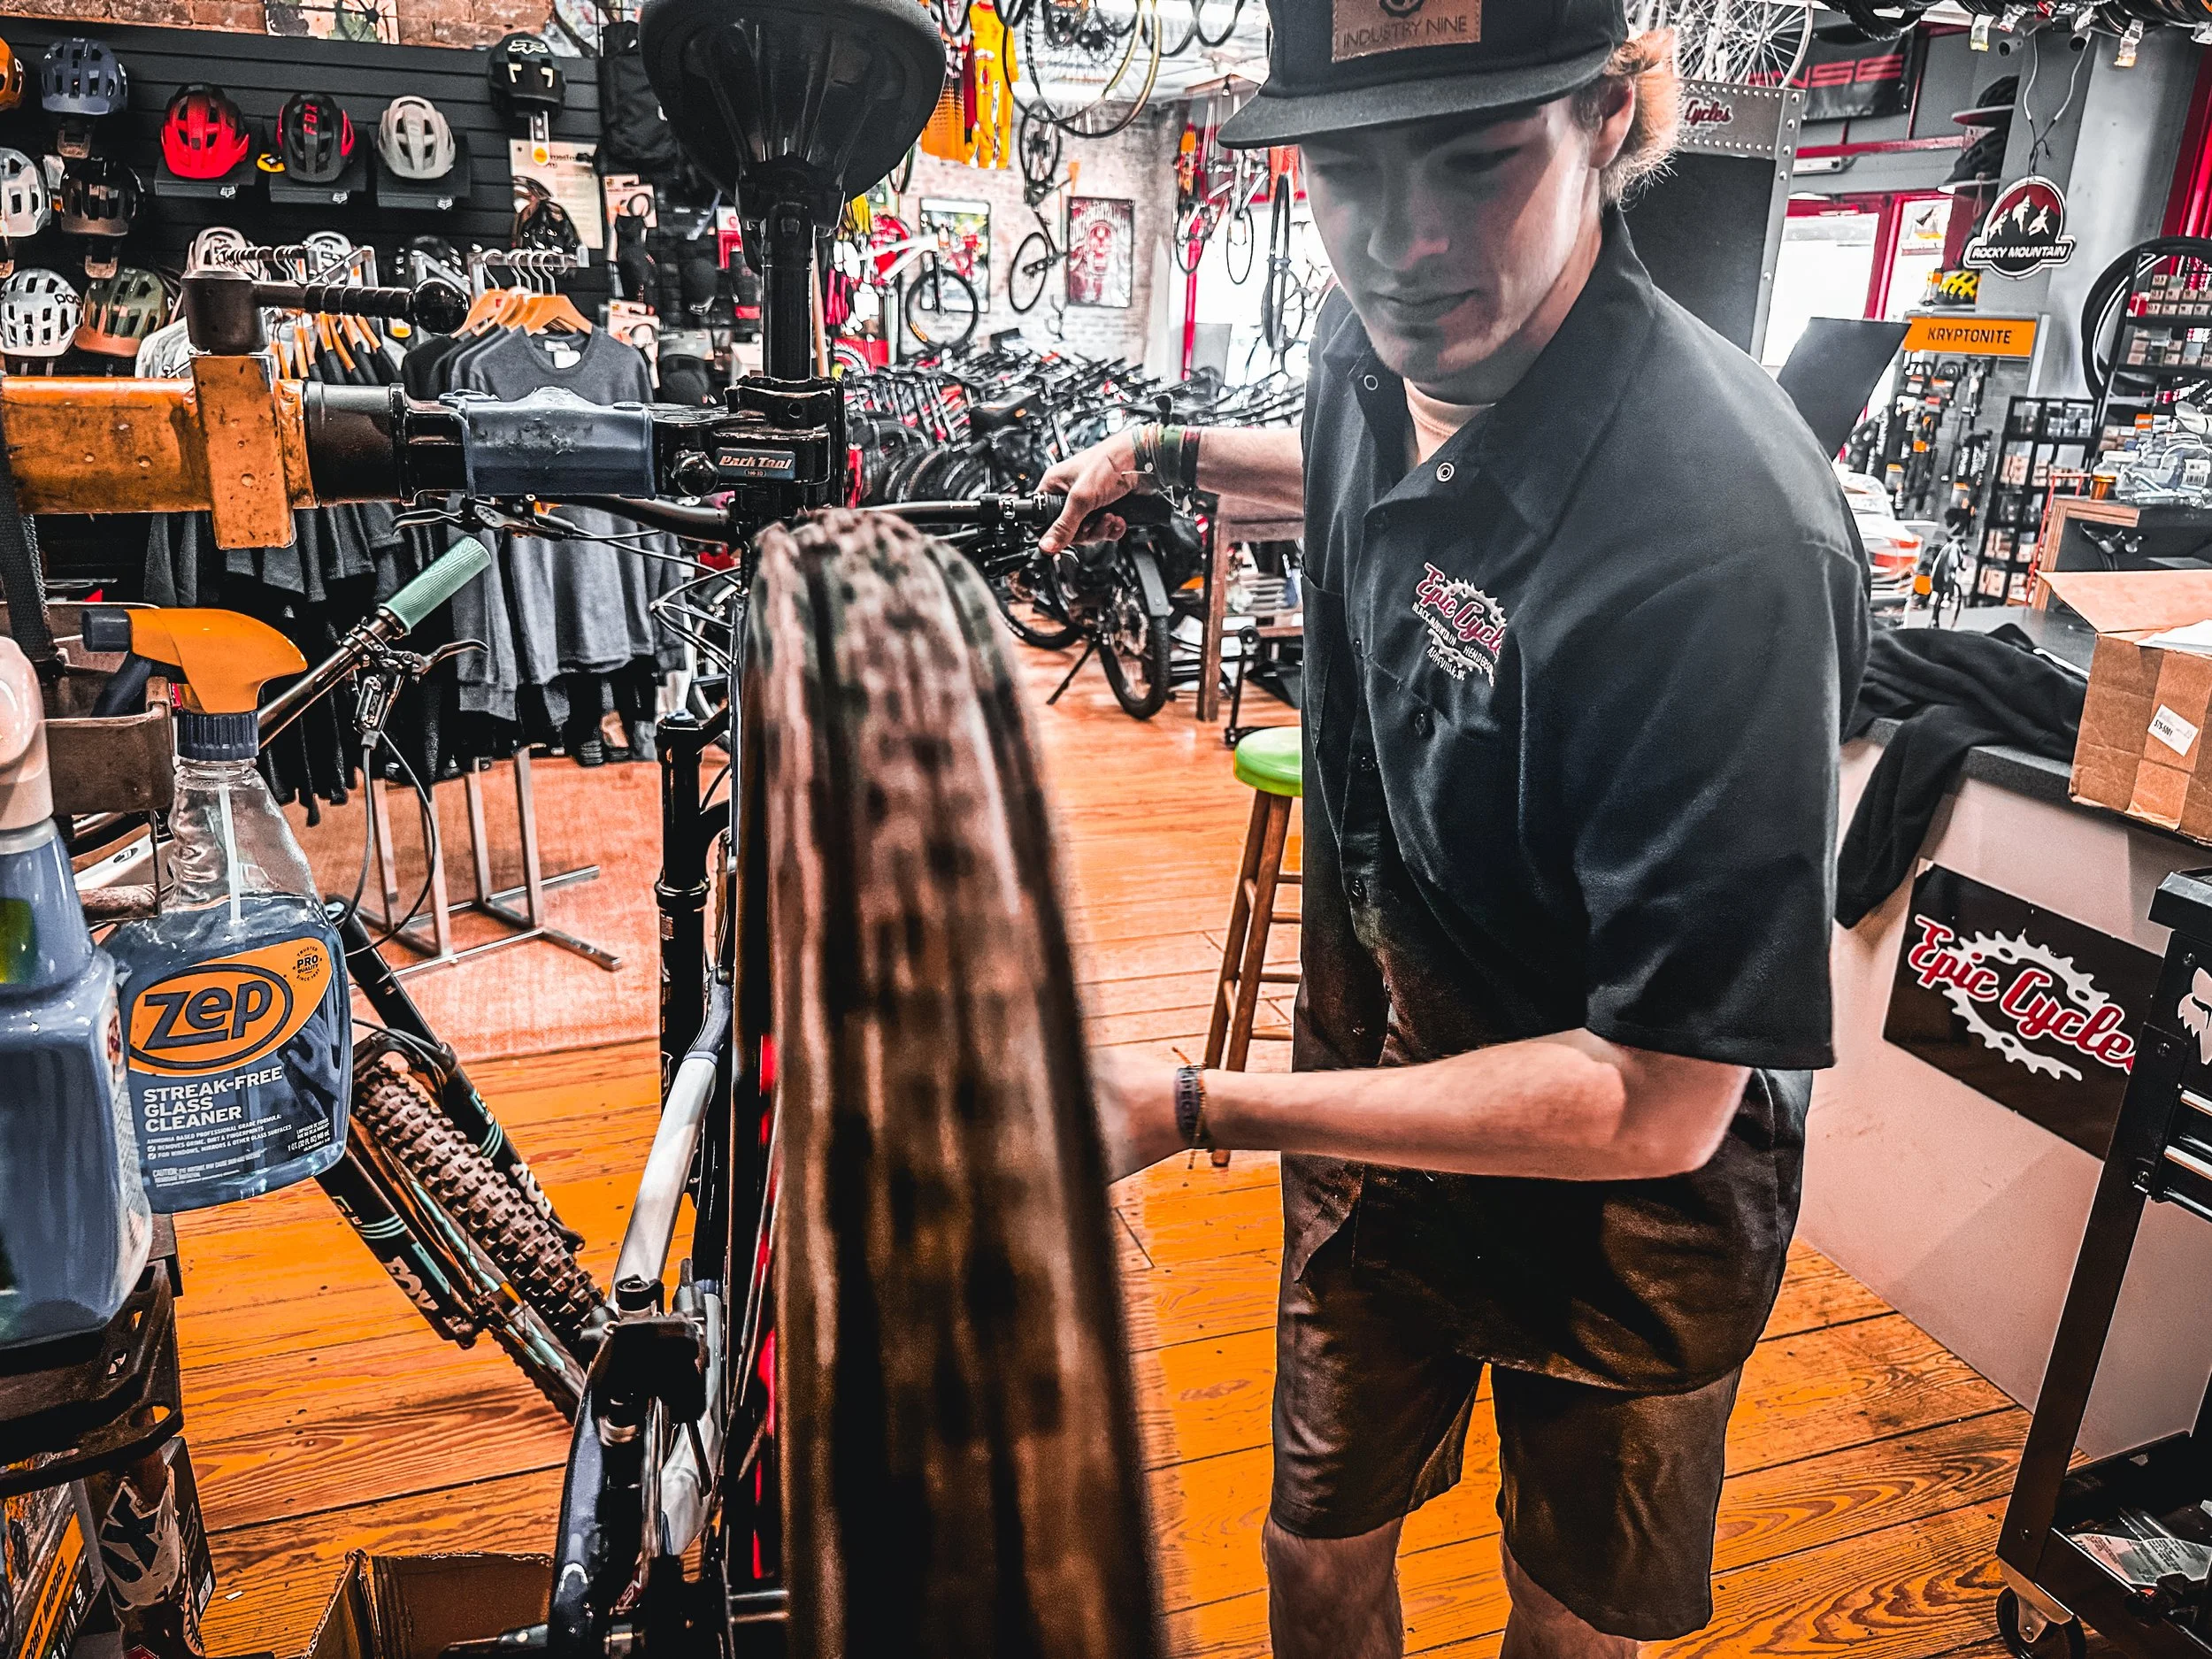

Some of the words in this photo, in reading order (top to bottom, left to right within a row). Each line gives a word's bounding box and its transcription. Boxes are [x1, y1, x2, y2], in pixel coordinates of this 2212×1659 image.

[1343, 18, 1423, 49] INDUSTRY
[1425, 15, 1467, 35] NINE
[303, 104, 319, 135] FOX
[1683, 97, 1733, 127] Cycles
[1971, 246, 2008, 258] ROCKY
[2008, 245, 2068, 258] MOUNTAIN
[1927, 326, 2012, 345] KRYPTONITE
[718, 455, 757, 468] Park
[757, 457, 793, 470] Tool
[1416, 561, 1458, 619] Epic
[1452, 601, 1507, 657] Cycl
[297, 954, 319, 969] PRO
[297, 963, 319, 974] QUALITY
[1908, 914, 2000, 1002] Epic
[143, 1065, 283, 1103] STREAK-FREE
[143, 1095, 214, 1118] GLASS
[144, 1105, 243, 1133] CLEANER
[196, 1125, 237, 1139] PROFESSIONAL
[237, 1121, 257, 1130] GRADE
[226, 1126, 265, 1140] FINGERPRINTS
[232, 1136, 250, 1146] OTHER
[250, 1131, 267, 1141] GLASS
[267, 1124, 293, 1136] SURFACES
[42, 1556, 67, 1624] MODEL
